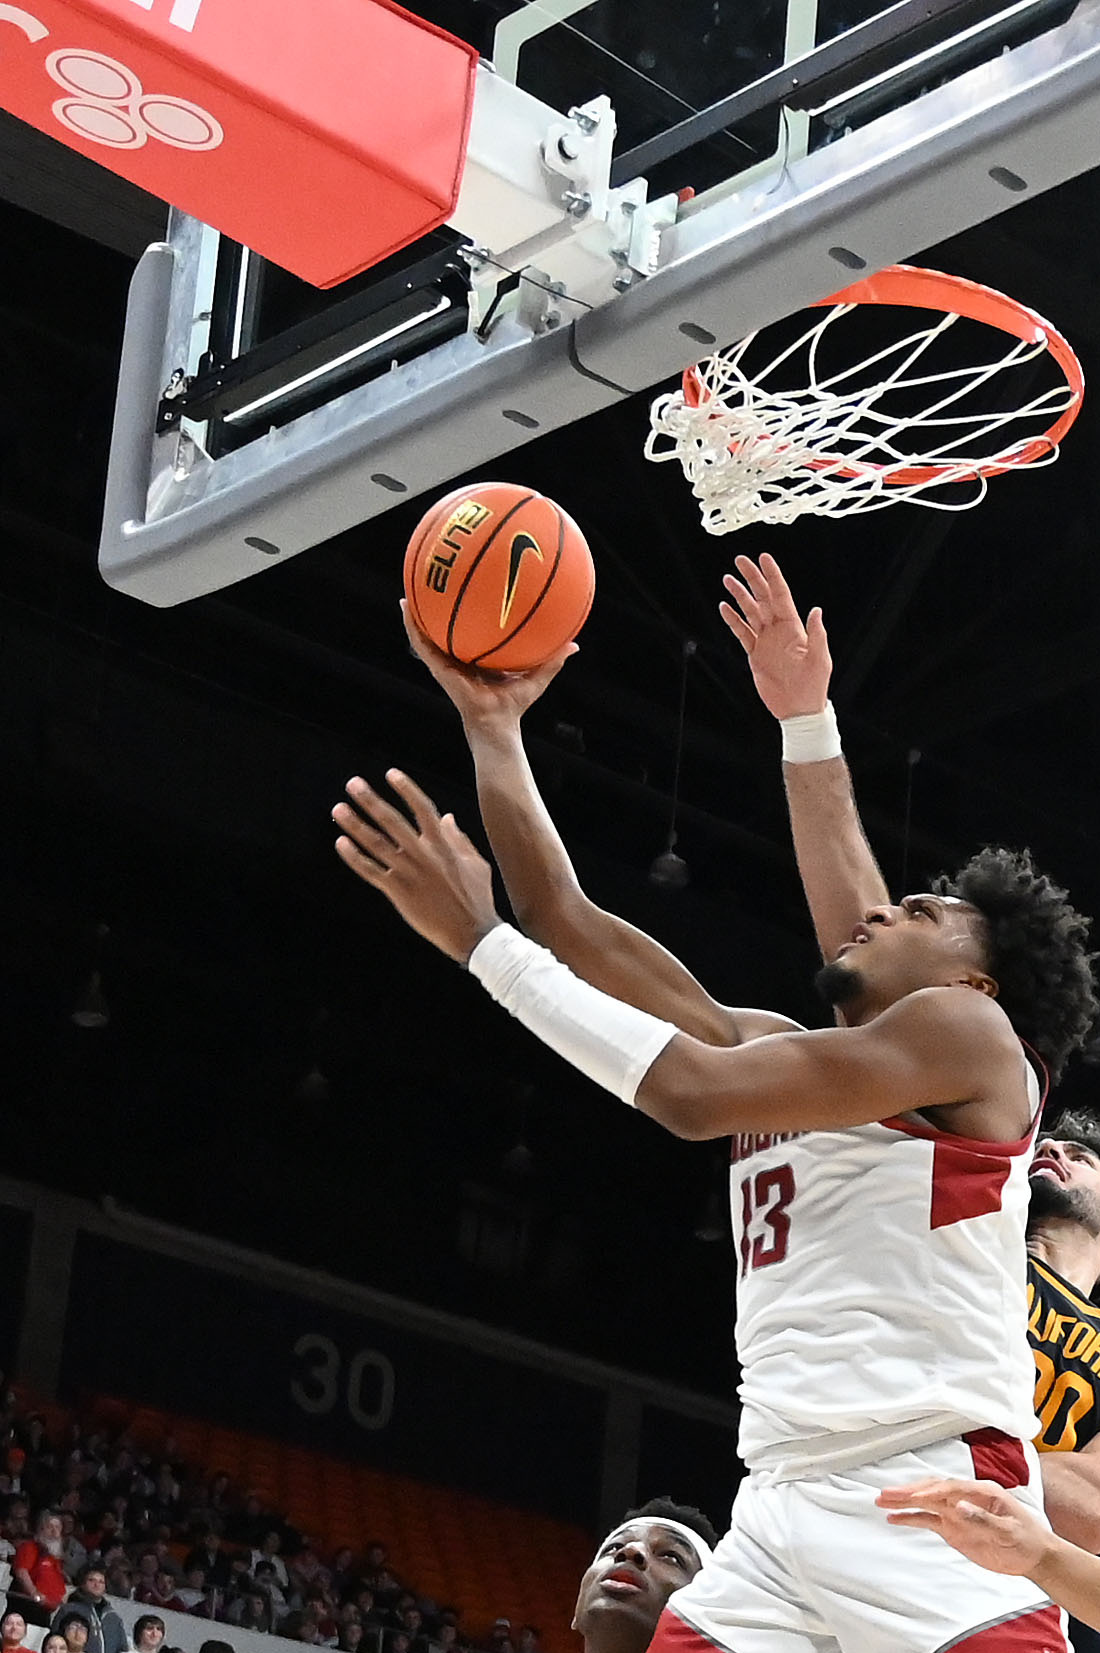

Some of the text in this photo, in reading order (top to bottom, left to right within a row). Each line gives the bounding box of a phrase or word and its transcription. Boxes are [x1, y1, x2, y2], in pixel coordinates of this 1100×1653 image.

[426, 499, 493, 593] ELITE
[741, 1162, 796, 1278] 13
[290, 1333, 395, 1429] 30
